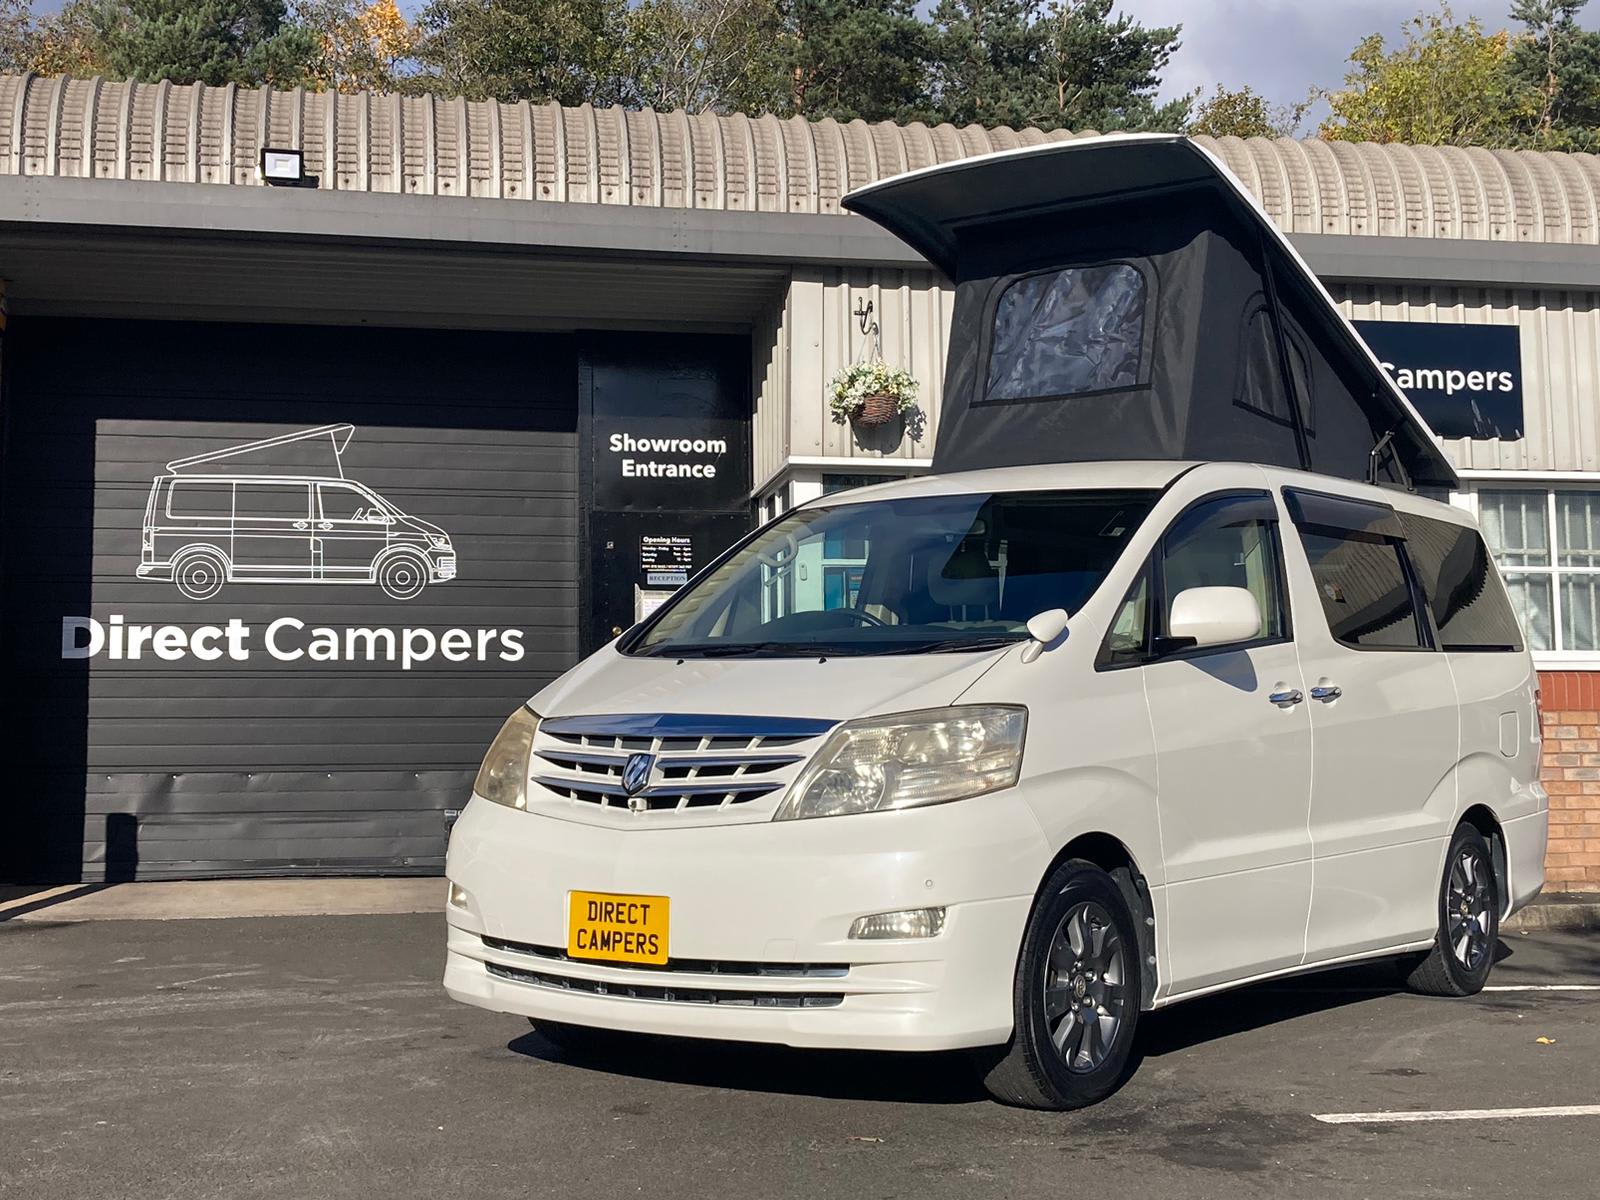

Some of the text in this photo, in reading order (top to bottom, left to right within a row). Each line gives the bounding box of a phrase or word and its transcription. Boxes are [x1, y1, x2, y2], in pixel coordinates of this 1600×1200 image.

[609, 432, 727, 454] Showroom
[621, 458, 717, 478] Entrance
[642, 536, 670, 544] Opening
[62, 614, 525, 670] Direct Campers
[587, 900, 651, 926] DIRECT
[576, 928, 659, 955] CAMPERS
